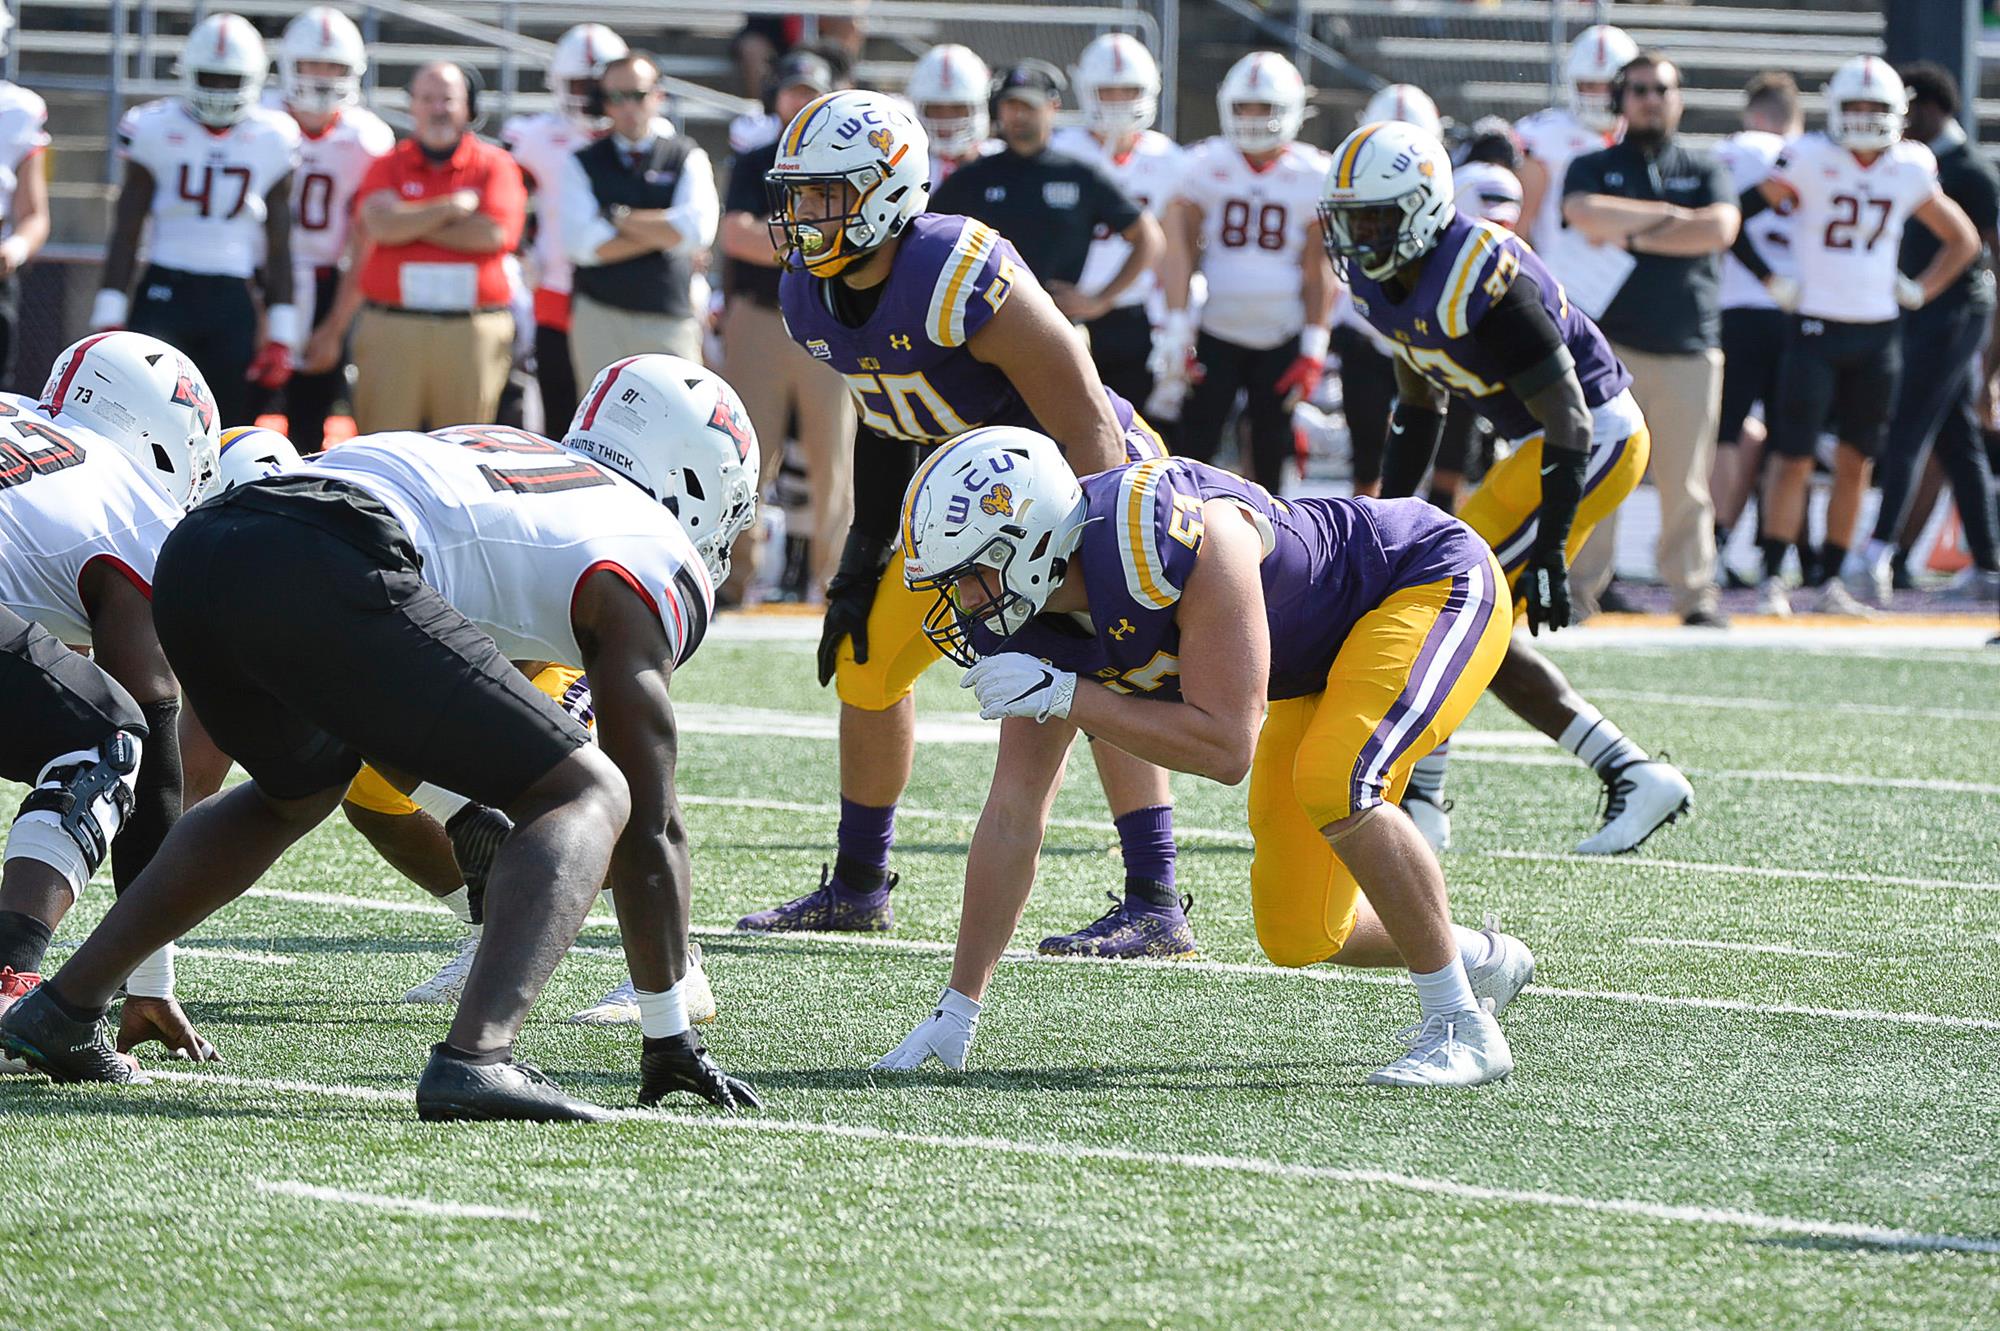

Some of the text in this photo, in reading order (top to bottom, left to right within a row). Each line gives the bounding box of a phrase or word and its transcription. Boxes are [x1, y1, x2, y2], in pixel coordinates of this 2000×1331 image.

[178, 163, 250, 219] 47
[1222, 199, 1286, 250] 88
[1824, 196, 1893, 251] 27
[73, 386, 93, 404] 73
[621, 388, 640, 404] 81
[568, 438, 634, 471] RUNS THICK
[946, 454, 1015, 524] WCU
